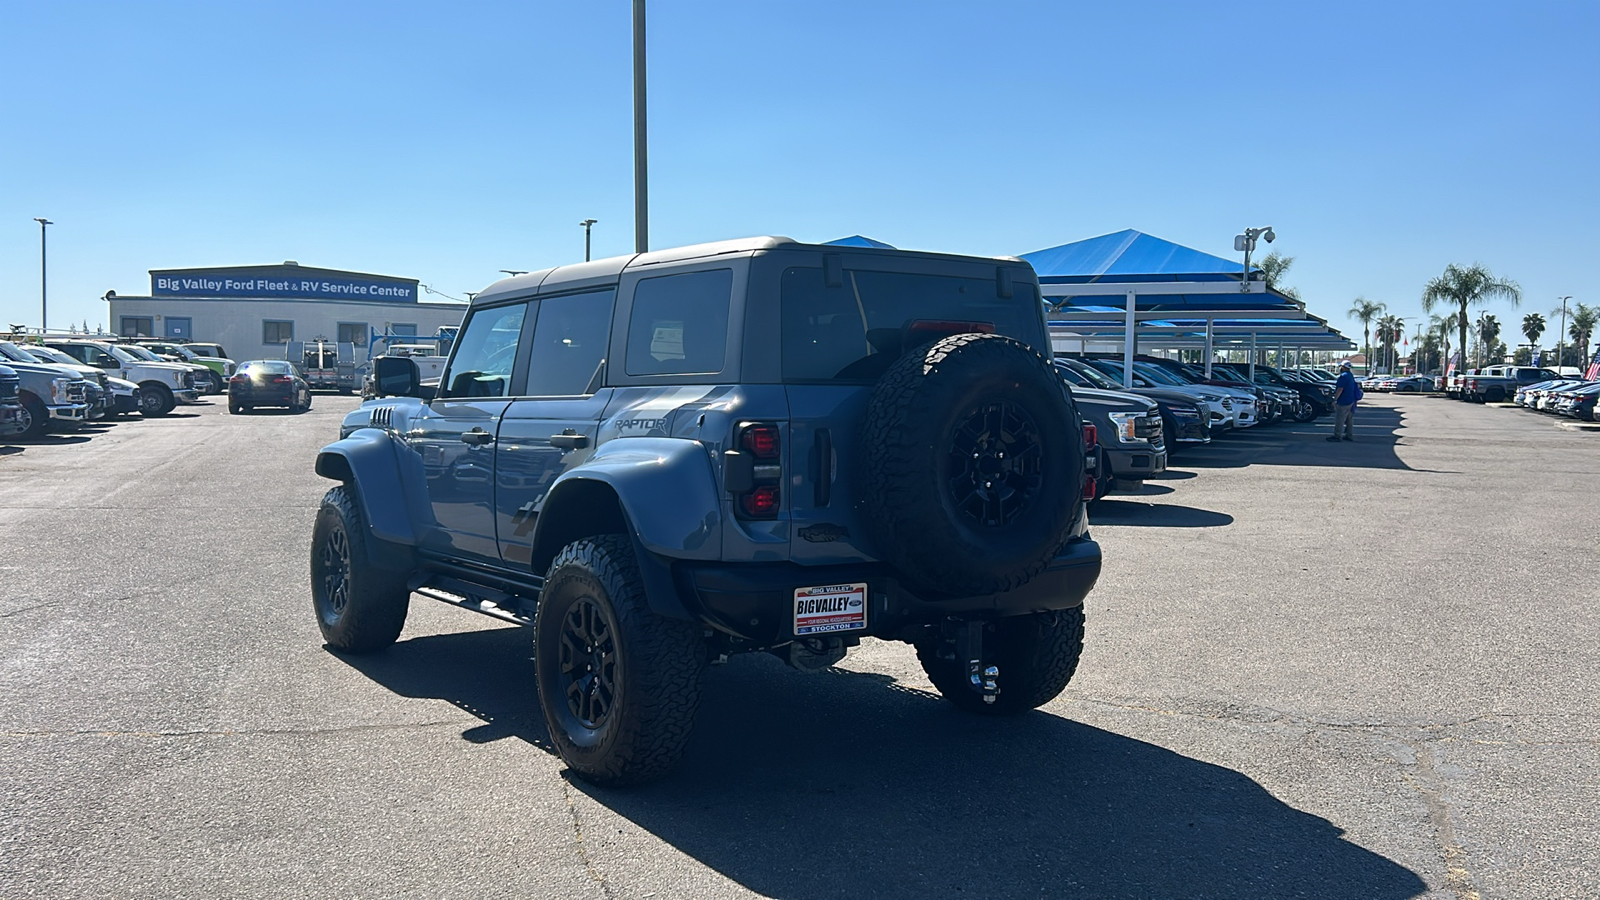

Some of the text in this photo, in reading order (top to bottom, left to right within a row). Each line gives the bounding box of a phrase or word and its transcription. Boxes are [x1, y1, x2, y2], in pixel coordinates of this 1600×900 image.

[158, 278, 410, 297] Big Valley Ford Fleet & RV Service Center
[614, 418, 667, 435] RAPTOR
[811, 624, 850, 632] STOCKTON
